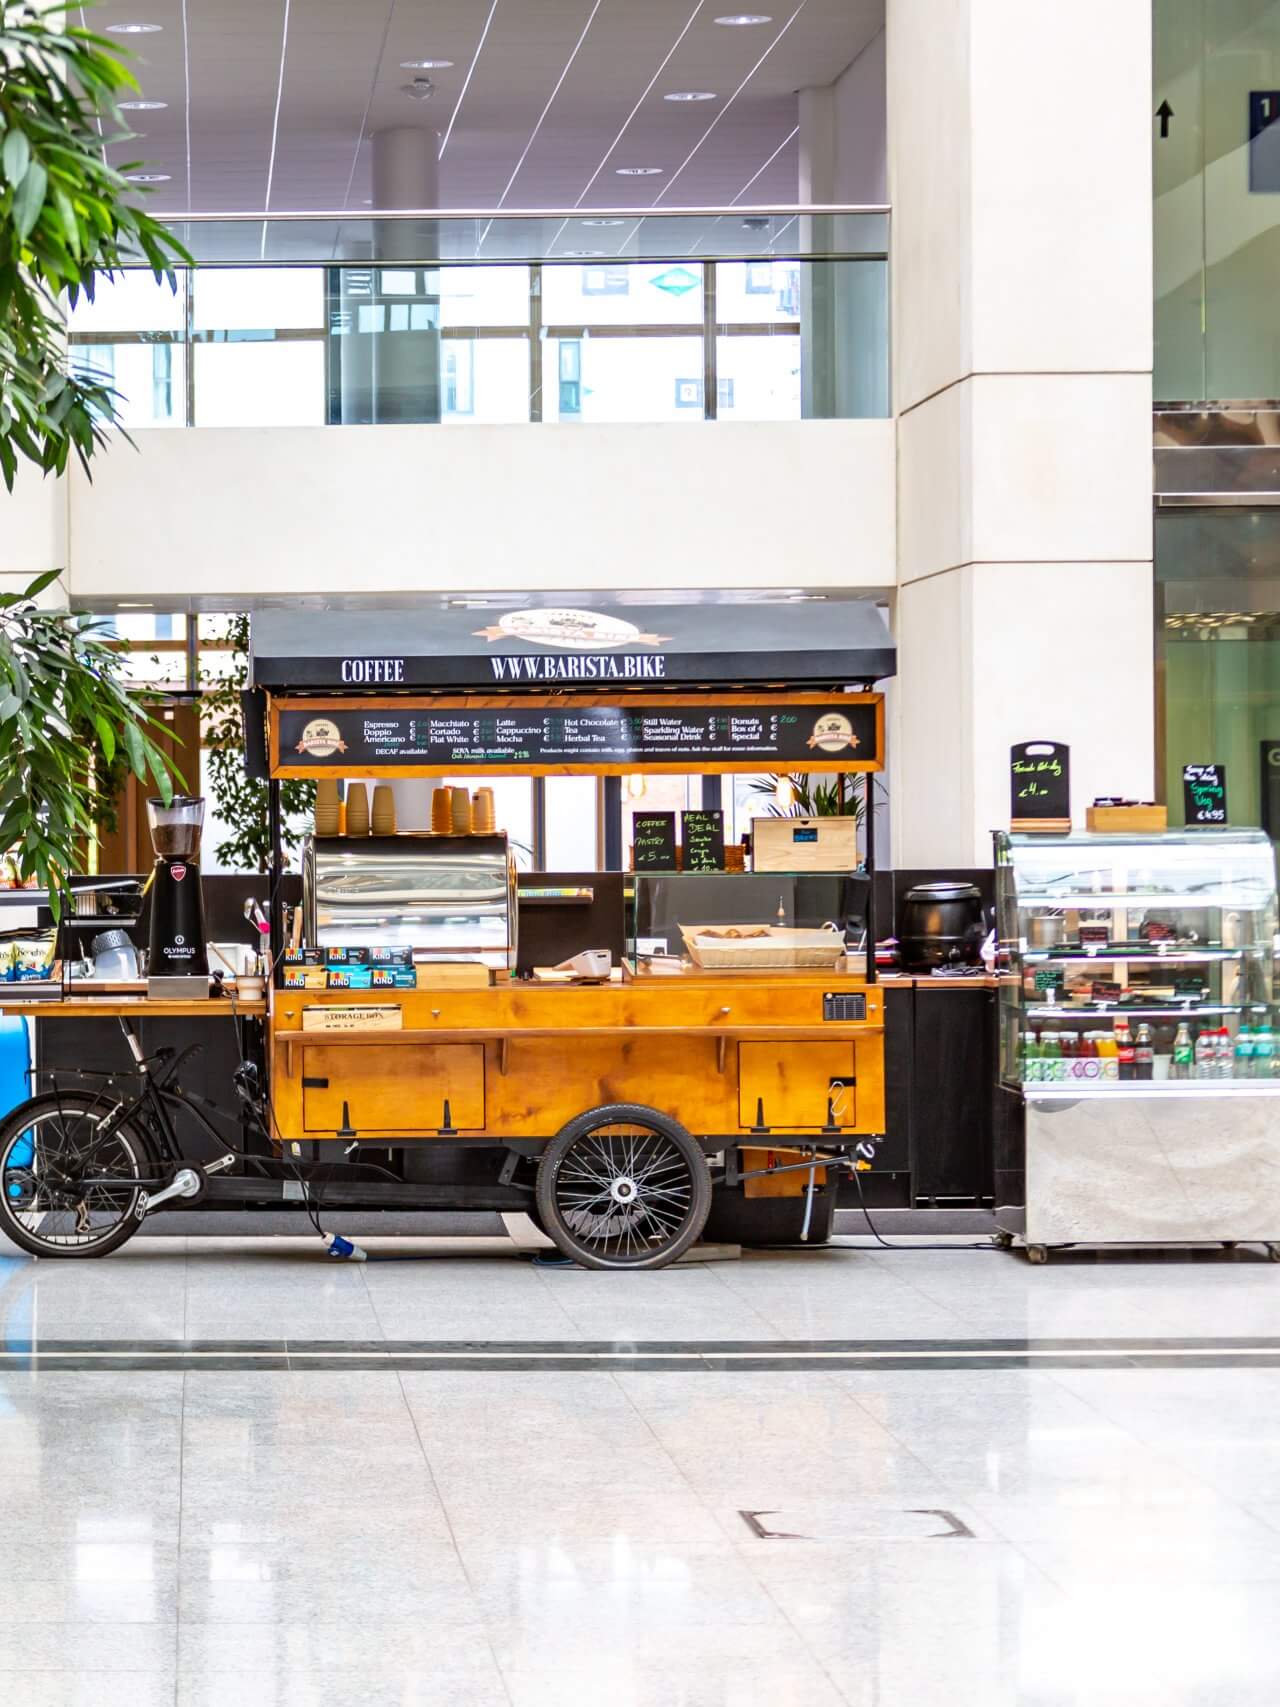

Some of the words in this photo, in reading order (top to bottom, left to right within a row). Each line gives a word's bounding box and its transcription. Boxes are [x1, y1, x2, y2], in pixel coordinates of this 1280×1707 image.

[1260, 97, 1270, 117] 1
[341, 659, 404, 682] COFFEE
[491, 656, 665, 679] WWW.BARISTA.BIKE
[363, 720, 399, 729] Espresso
[430, 720, 470, 728] Macchiato
[496, 718, 516, 726] Latte
[579, 718, 619, 726] Chocolate
[643, 718, 658, 726] Still
[731, 717, 760, 725] Donuts
[363, 728, 392, 737] Doppio
[496, 726, 542, 736] Cappuccino
[565, 726, 578, 734] Tea
[643, 726, 681, 735] Sparkling
[682, 726, 704, 734] Water
[731, 725, 746, 733] Box
[747, 725, 755, 733] of
[364, 735, 406, 743] Americano
[430, 735, 445, 743] Flat
[446, 735, 469, 743] White
[564, 734, 591, 742] Herbal
[592, 734, 606, 742] Tea
[732, 732, 760, 741] Special
[635, 820, 668, 828] COFFEE
[688, 823, 720, 834] DEAL
[635, 837, 665, 849] PASTRY
[163, 947, 196, 955] OLYMPUS
[285, 953, 303, 961] KIND
[285, 979, 304, 987] KIND
[329, 978, 349, 986] KIND
[373, 976, 393, 985] KIND
